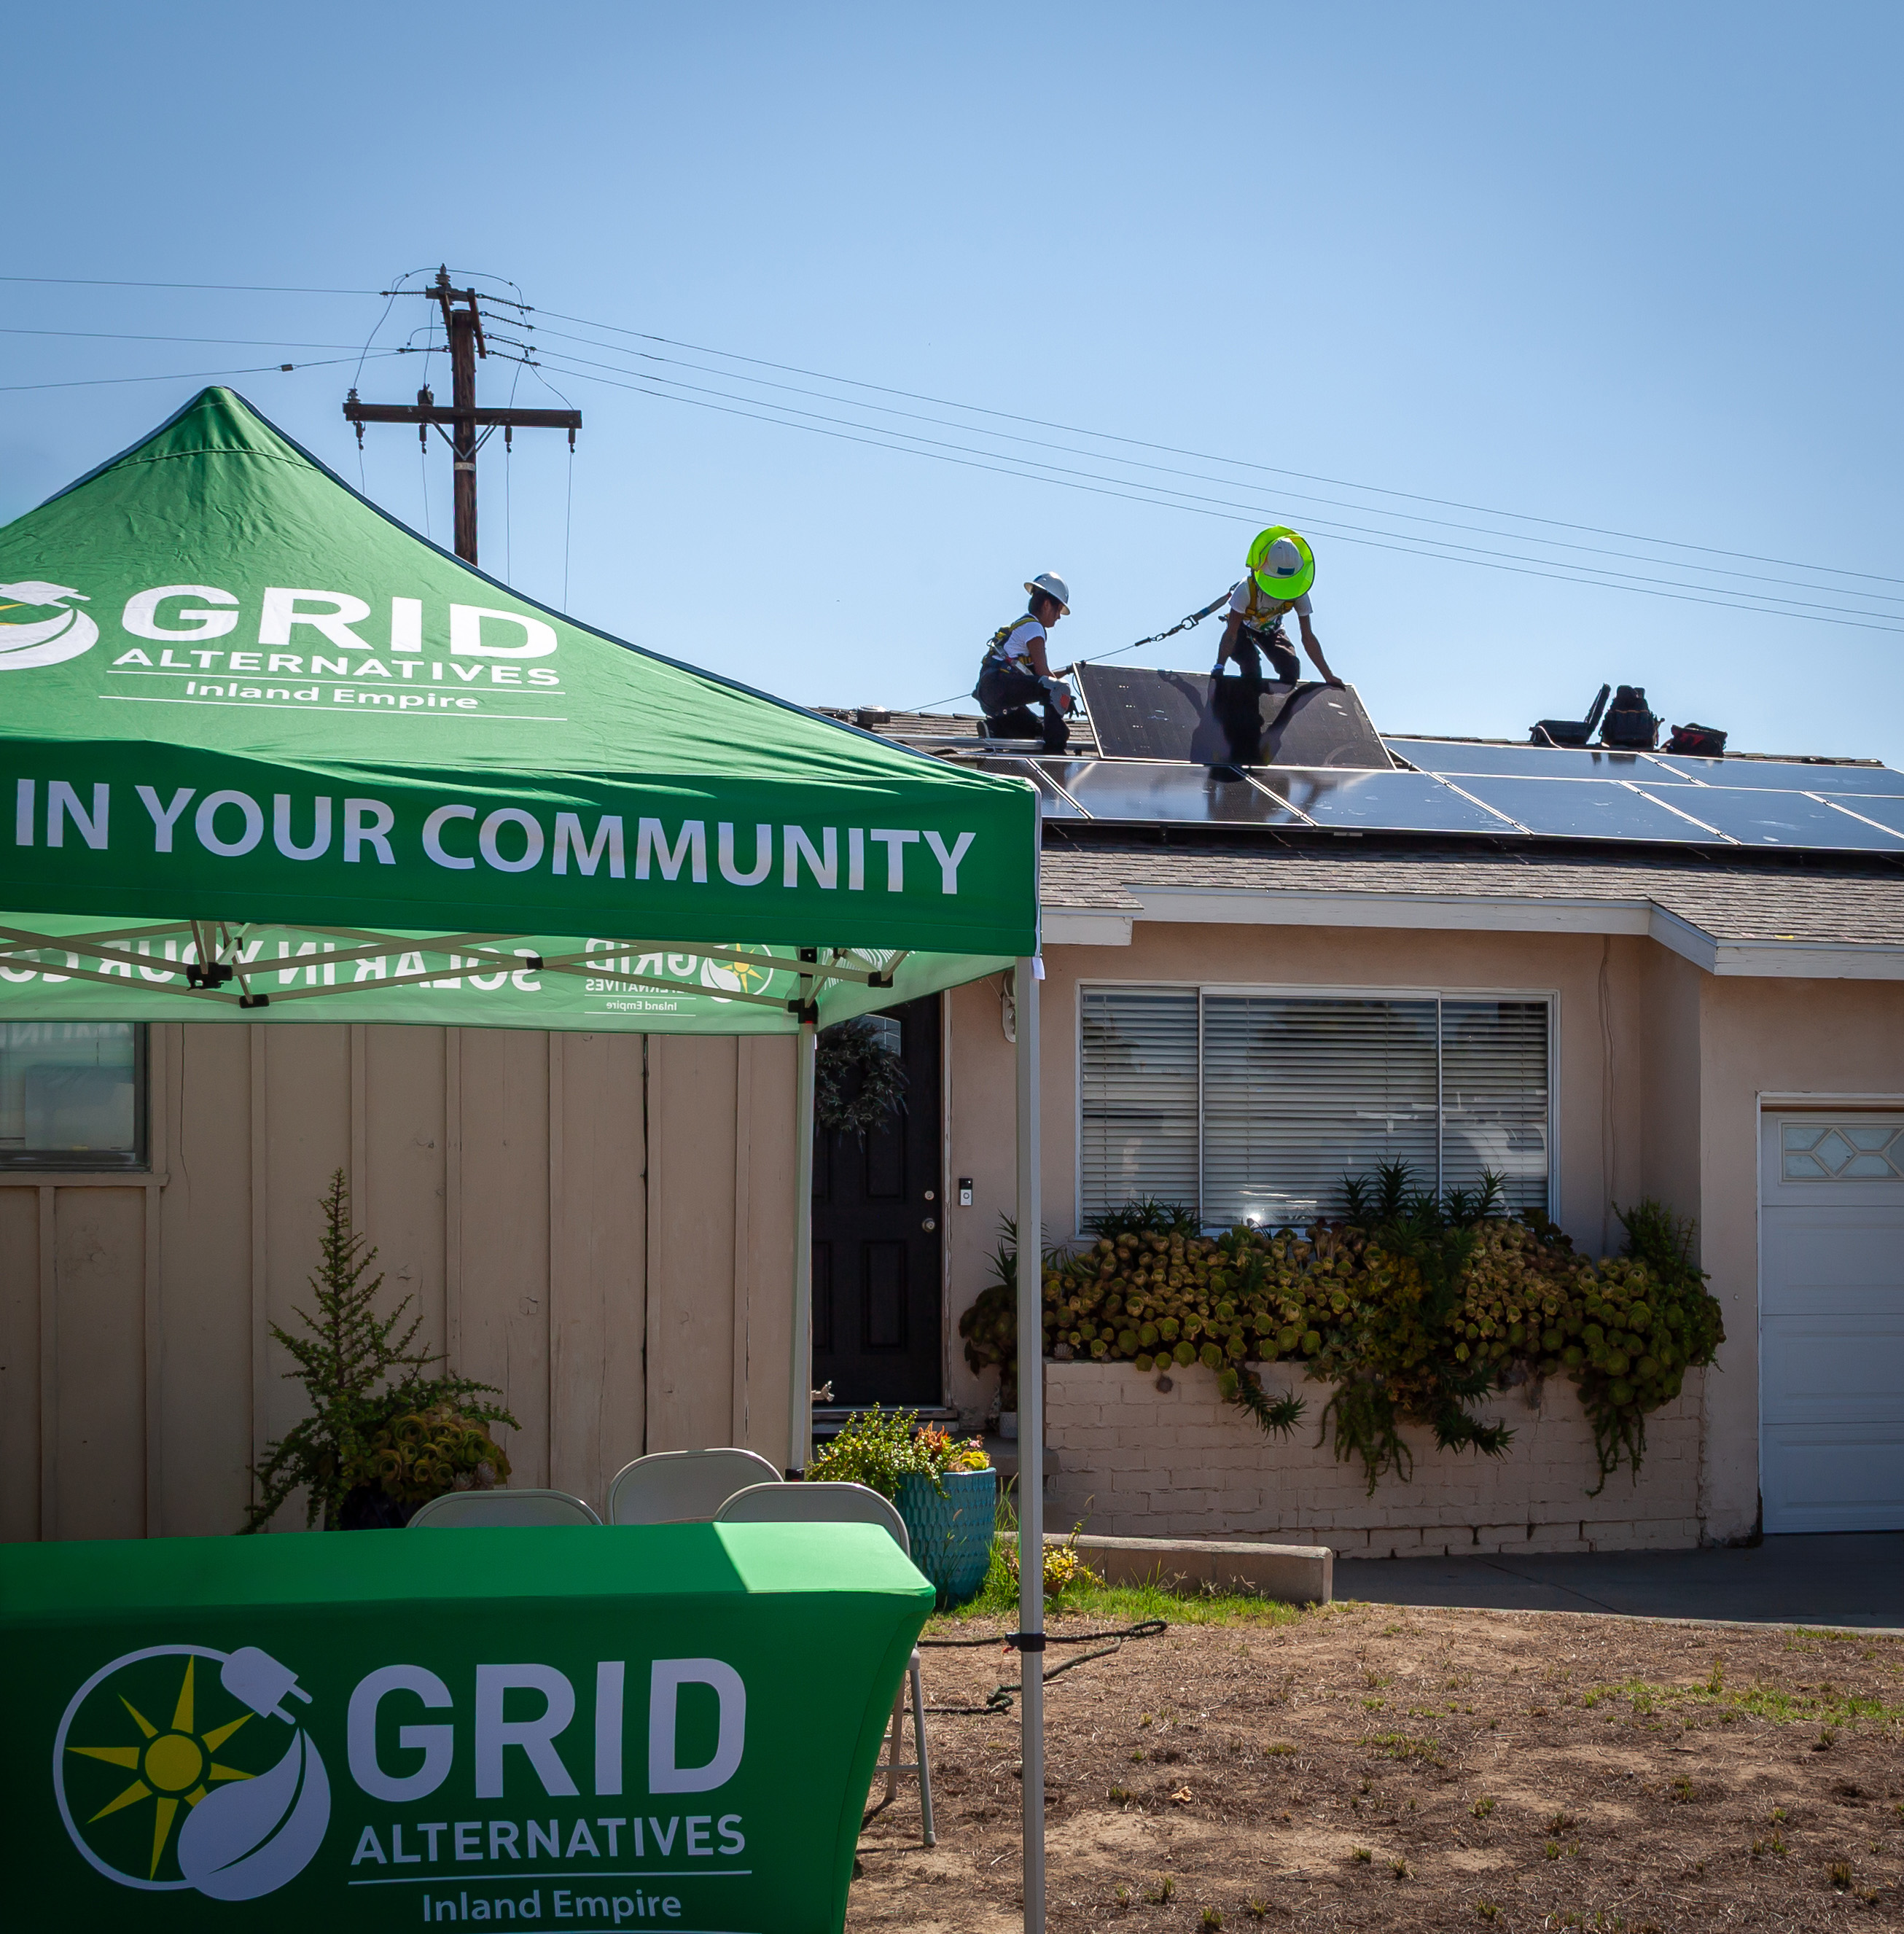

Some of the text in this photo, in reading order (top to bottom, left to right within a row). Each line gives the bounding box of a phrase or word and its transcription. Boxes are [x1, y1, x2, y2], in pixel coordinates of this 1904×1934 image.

[122, 585, 559, 659] GRID
[112, 648, 560, 686] ALTERNATIVES
[186, 681, 478, 709] Inland Empire
[16, 779, 976, 894] IN YOUR COMMUNITY
[348, 1658, 746, 1801] GRID
[351, 1814, 746, 1865] ALTERNATIVES
[424, 1889, 682, 1924] Inland Empire
